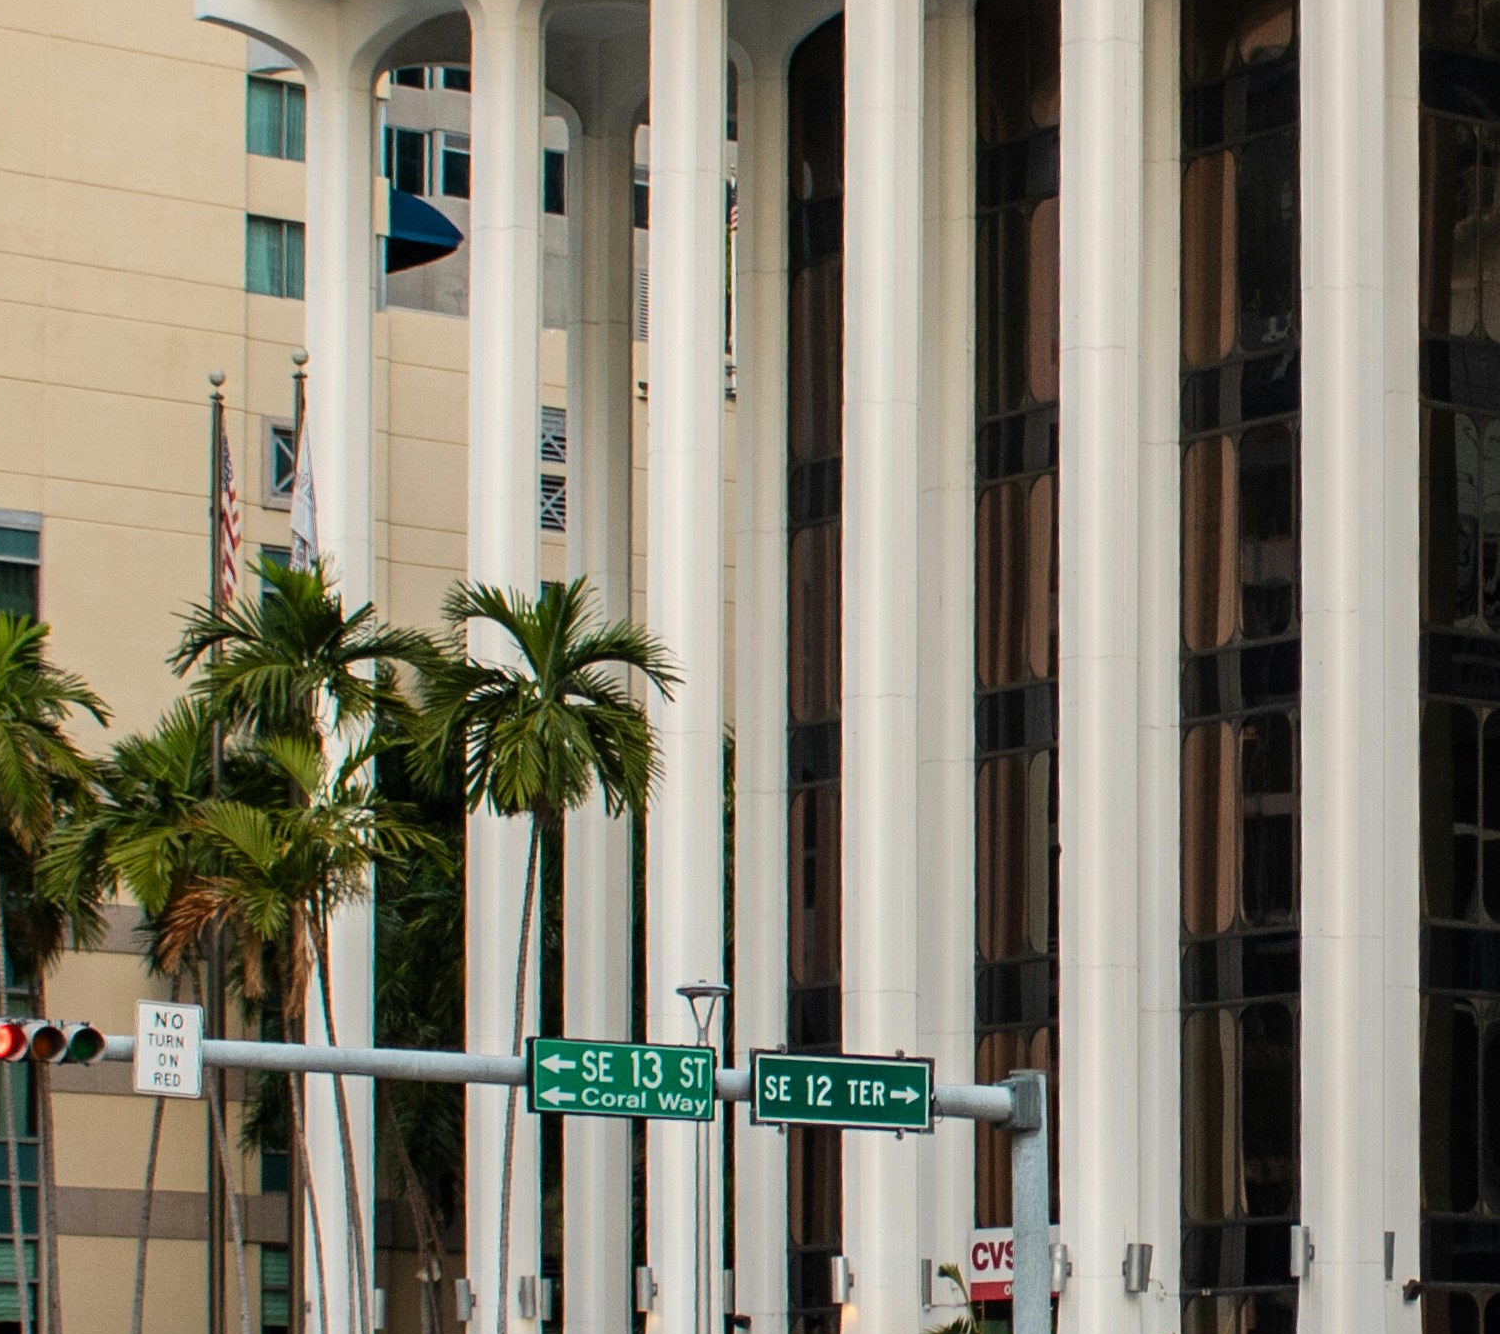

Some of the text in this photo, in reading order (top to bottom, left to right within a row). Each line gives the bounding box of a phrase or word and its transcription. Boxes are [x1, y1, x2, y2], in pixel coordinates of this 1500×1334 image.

[153, 1011, 184, 1030] NO
[147, 1033, 186, 1049] TURN
[157, 1053, 179, 1068] ON
[581, 1050, 708, 1089] SE 13 ST
[153, 1071, 182, 1088] RED
[764, 1074, 886, 1107] SE 12 TER
[581, 1087, 707, 1116] Coral Way
